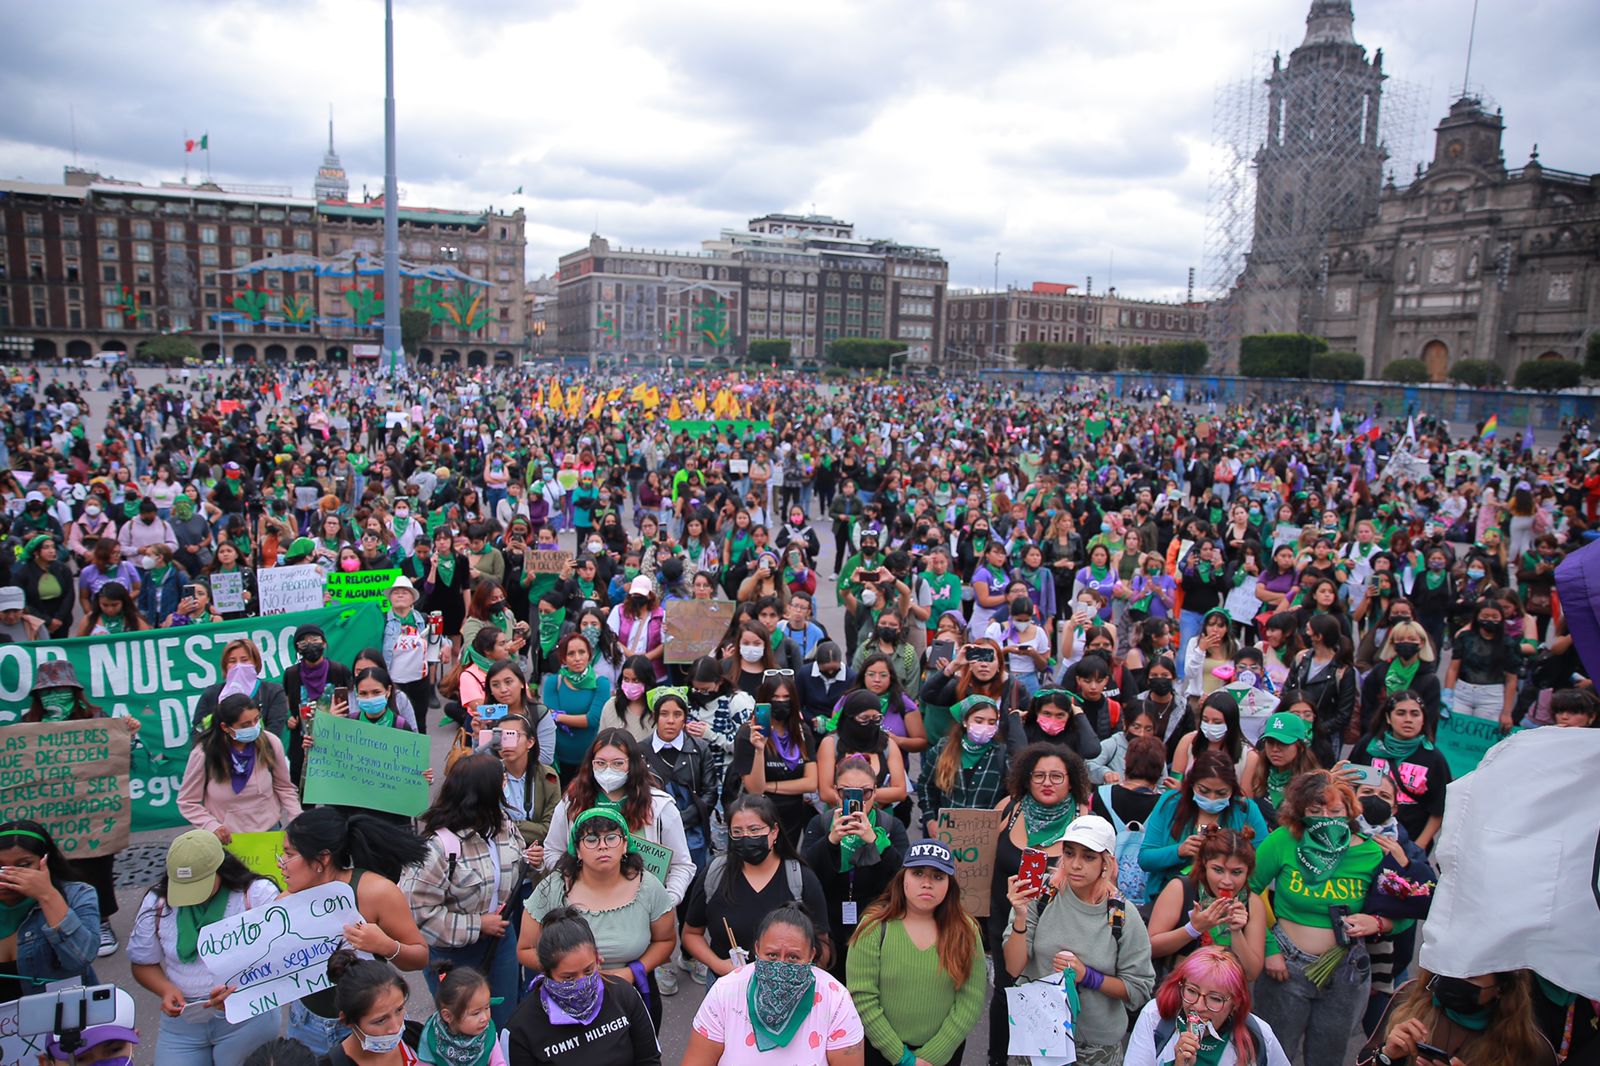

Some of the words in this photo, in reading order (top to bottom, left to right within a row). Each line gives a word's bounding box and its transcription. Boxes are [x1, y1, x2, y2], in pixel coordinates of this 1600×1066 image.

[328, 574, 341, 584] LA
[345, 574, 390, 584] RELIGION
[328, 589, 342, 598] DE
[37, 728, 110, 747] MUJERES
[35, 746, 109, 766] DECIDEN
[0, 781, 75, 804] ERECEN
[87, 775, 119, 795] SER
[633, 839, 667, 860] BORTAR
[911, 844, 951, 861] NYPD
[952, 847, 979, 862] NO
[200, 917, 264, 957] aborto
[310, 894, 352, 918] con
[249, 991, 279, 1016] SIN
[288, 972, 301, 988] Y
[544, 1036, 580, 1057] TOMMY
[585, 1015, 630, 1042] HILFIGER
